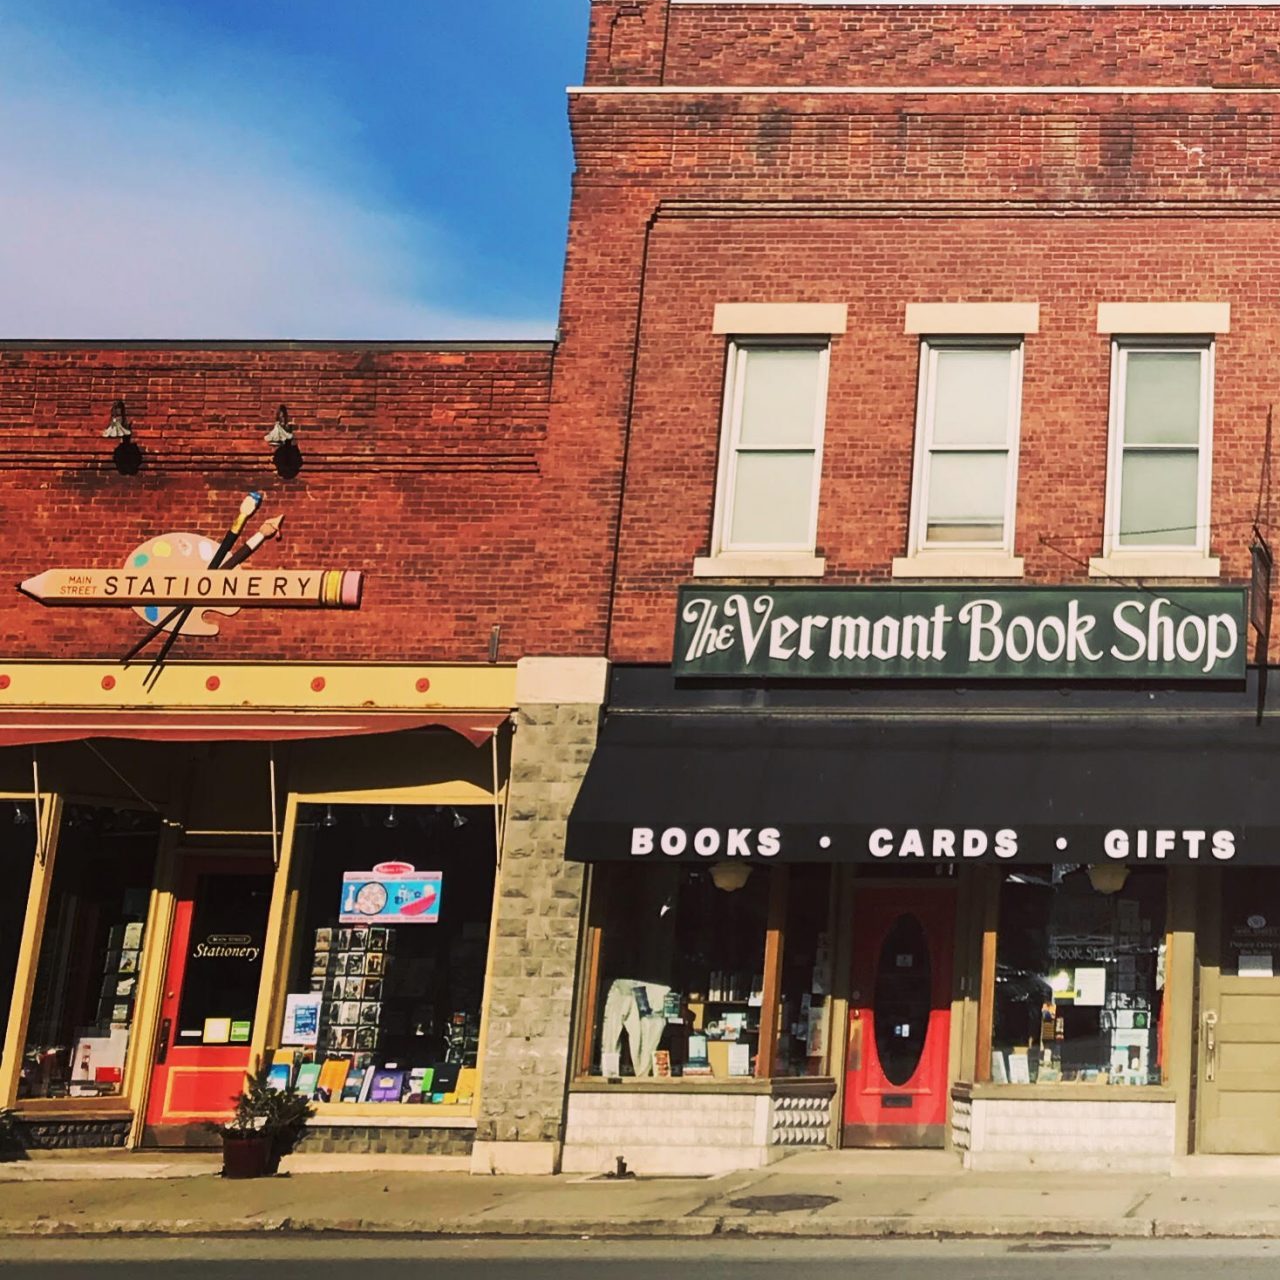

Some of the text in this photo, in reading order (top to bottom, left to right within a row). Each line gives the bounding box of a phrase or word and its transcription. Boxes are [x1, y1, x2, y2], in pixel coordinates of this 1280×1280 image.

[68, 575, 92, 585] MAIN
[104, 576, 311, 596] STATIONERY
[59, 585, 98, 595] STREET
[682, 593, 1238, 673] The Vermont Book Shop
[630, 827, 1236, 860] BOOKS CARDS GIFTS
[193, 943, 260, 962] Stationery
